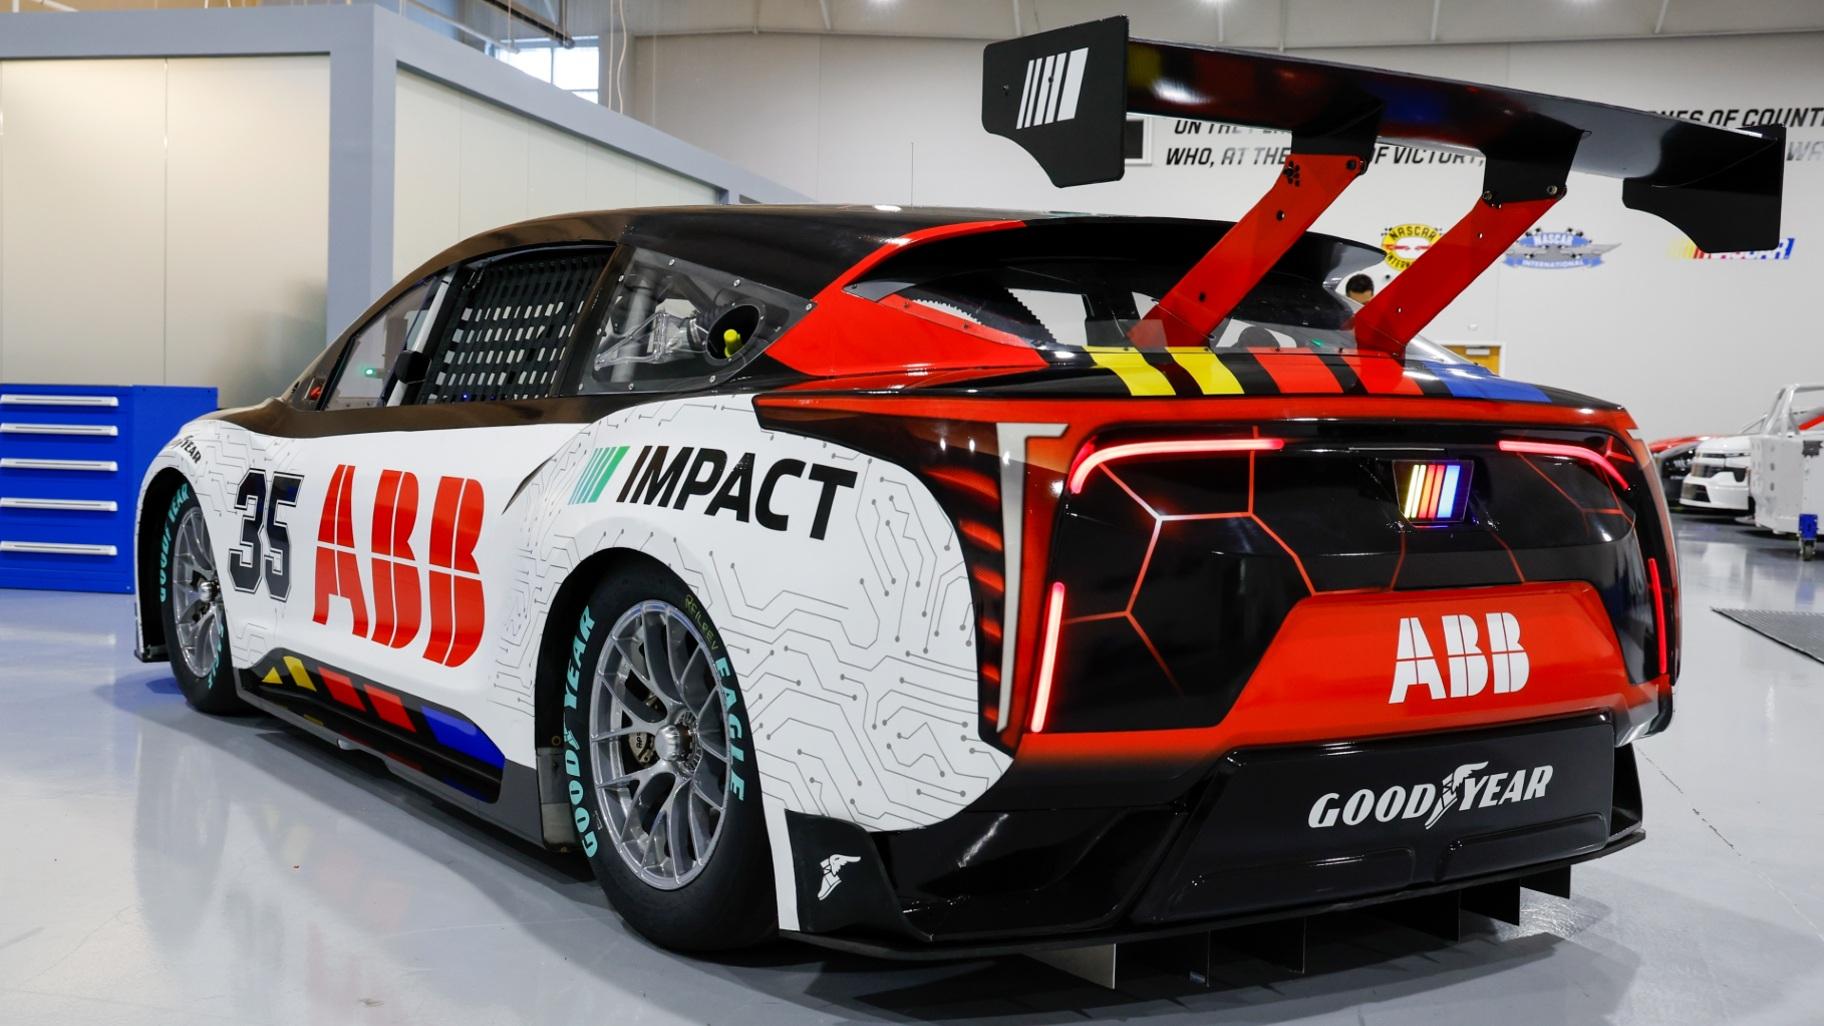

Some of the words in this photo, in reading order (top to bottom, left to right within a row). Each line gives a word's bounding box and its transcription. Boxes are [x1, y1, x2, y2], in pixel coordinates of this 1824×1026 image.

[1166, 147, 1215, 168] WHO,
[1221, 147, 1250, 165] AT
[1253, 147, 1292, 165] THE
[1742, 107, 1824, 128] COUNT
[1389, 225, 1437, 241] NASCAR
[227, 467, 305, 603] 35
[616, 445, 858, 541] IMPACT
[312, 463, 485, 668] ABB
[1388, 612, 1530, 704] ABB
[714, 656, 745, 801] EAGLE
